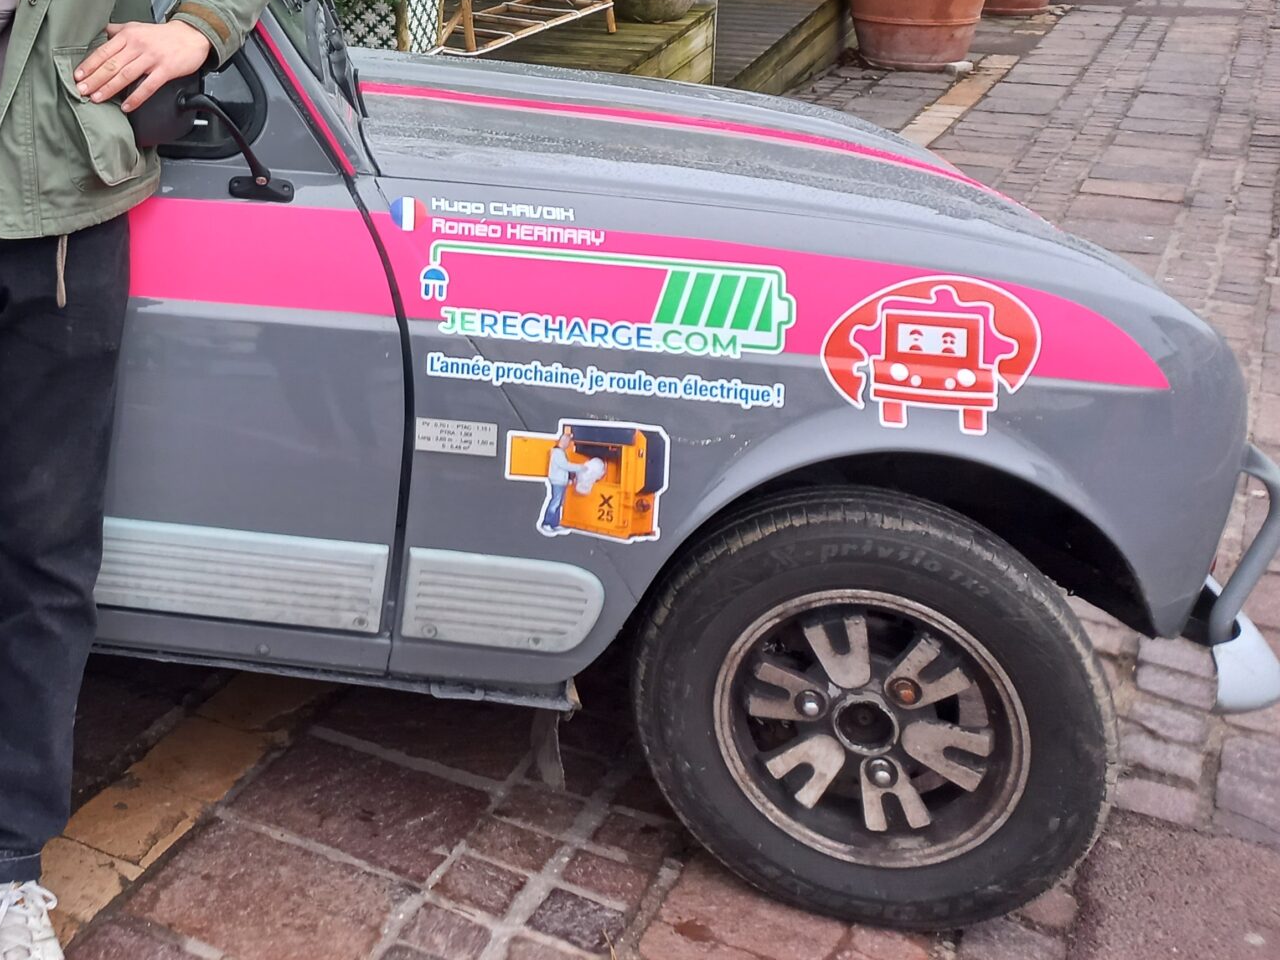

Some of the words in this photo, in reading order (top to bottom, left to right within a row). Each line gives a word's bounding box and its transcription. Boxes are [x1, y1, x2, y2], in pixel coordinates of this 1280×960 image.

[431, 197, 485, 215] Hugo
[431, 217, 502, 238] Roméo
[506, 223, 605, 247] HERMARY
[442, 309, 738, 355] JERECHARGE.COM
[429, 355, 491, 377] L'année
[495, 364, 584, 387] prochaine,
[587, 369, 604, 391] je
[609, 374, 653, 392] roule
[657, 381, 678, 395] en
[683, 378, 771, 405] électrique
[598, 493, 615, 509] X
[597, 508, 615, 523] 25
